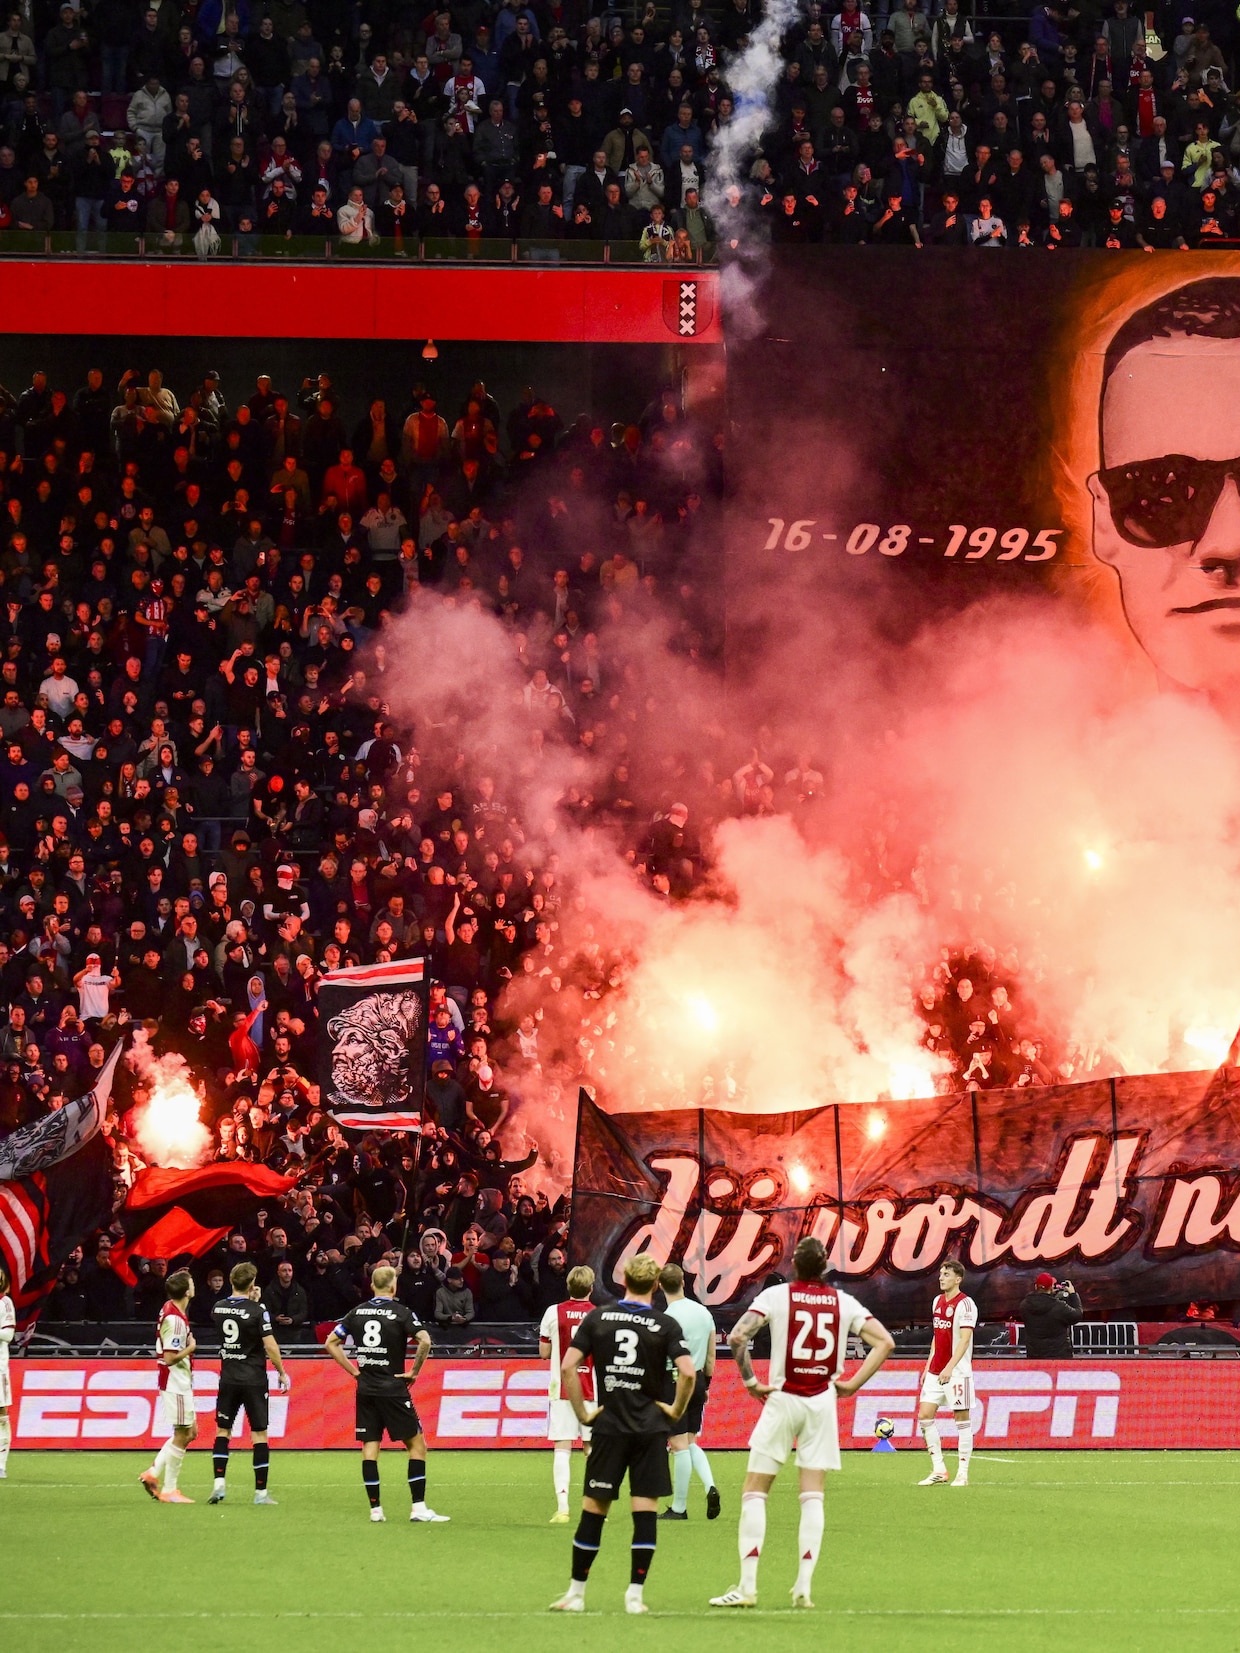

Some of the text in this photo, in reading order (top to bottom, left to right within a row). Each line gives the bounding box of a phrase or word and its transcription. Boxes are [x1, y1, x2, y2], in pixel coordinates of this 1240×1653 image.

[611, 1156, 775, 1304] Jij
[808, 1136, 1141, 1274] wordt
[791, 1291, 837, 1306] WEGHORST
[566, 1310, 587, 1320] TAYLO
[222, 1318, 240, 1344] 9
[362, 1319, 382, 1348] 8
[791, 1309, 836, 1361] 25
[613, 1328, 640, 1366] 3
[436, 1370, 549, 1437] ES
[952, 1383, 964, 1397] 15
